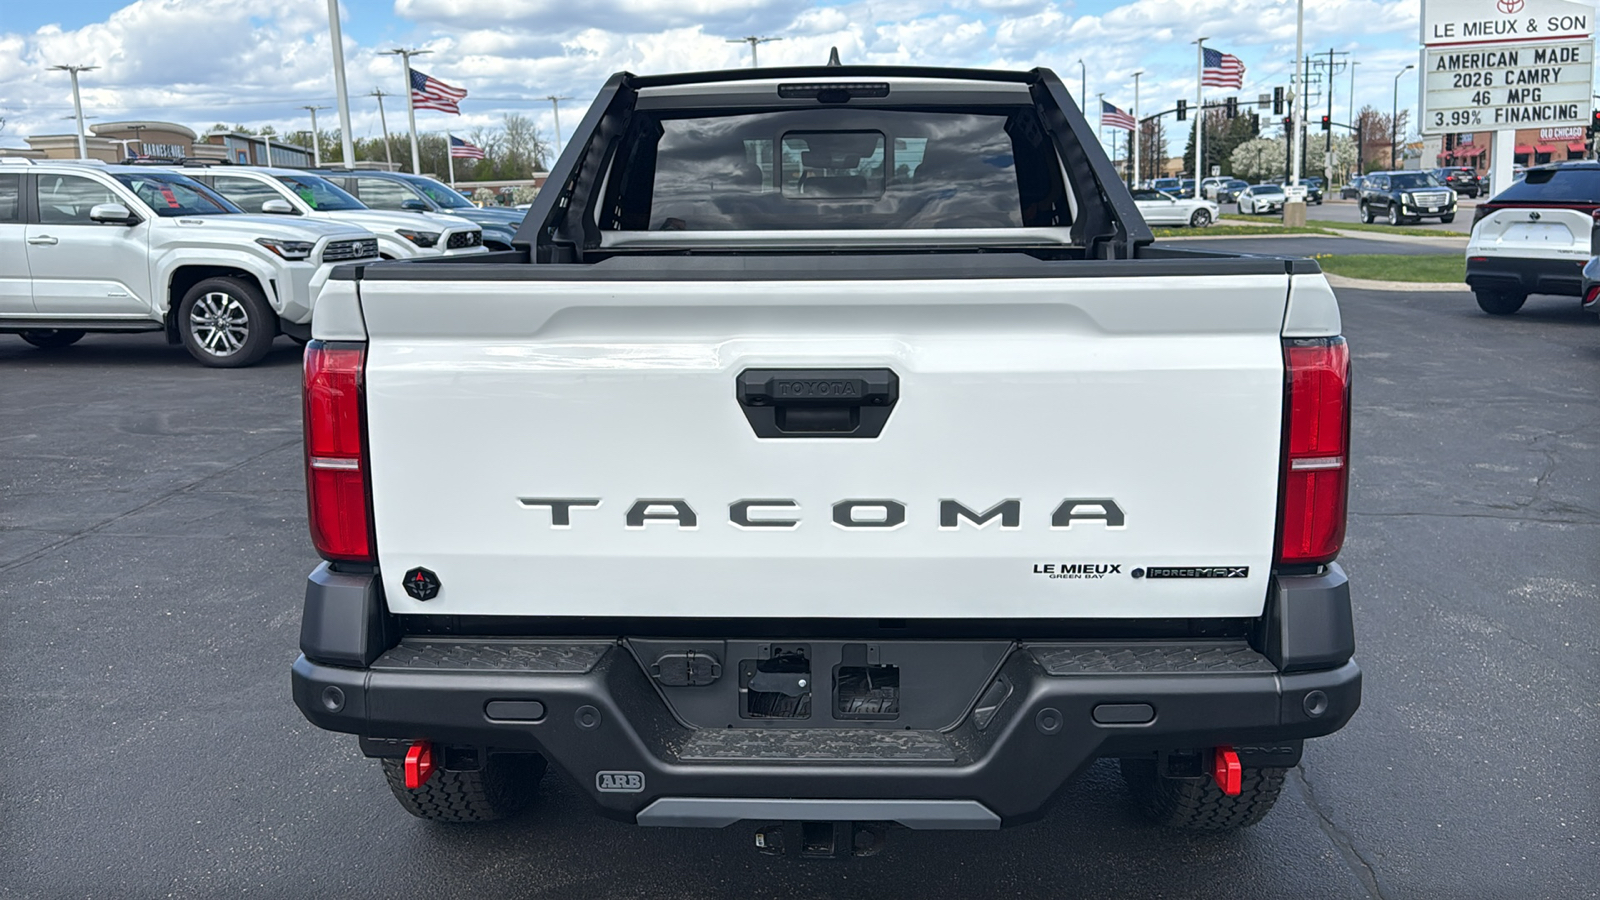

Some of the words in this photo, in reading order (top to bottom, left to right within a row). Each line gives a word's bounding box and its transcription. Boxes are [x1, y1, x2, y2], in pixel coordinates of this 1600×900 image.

[1434, 23, 1455, 38] LE
[1463, 19, 1518, 37] MIEUX
[1526, 18, 1538, 33] &
[1547, 15, 1587, 32] SON
[1436, 51, 1519, 71] AMERICAN
[1534, 47, 1580, 64] MADE
[1453, 72, 1493, 88] 2026
[1505, 67, 1562, 85] CAMRY
[1471, 91, 1491, 105] 46
[1507, 87, 1542, 104] MPG
[1435, 110, 1481, 127] 3.99%
[1495, 104, 1578, 123] FINANCING
[1540, 127, 1553, 139] OLD
[1554, 126, 1583, 138] CHICAGO
[779, 381, 856, 396] TOYOTA
[517, 497, 1128, 529] TACOMA
[1033, 564, 1056, 574] LE
[1061, 564, 1122, 574] MIEUX
[601, 774, 641, 789] ARB
